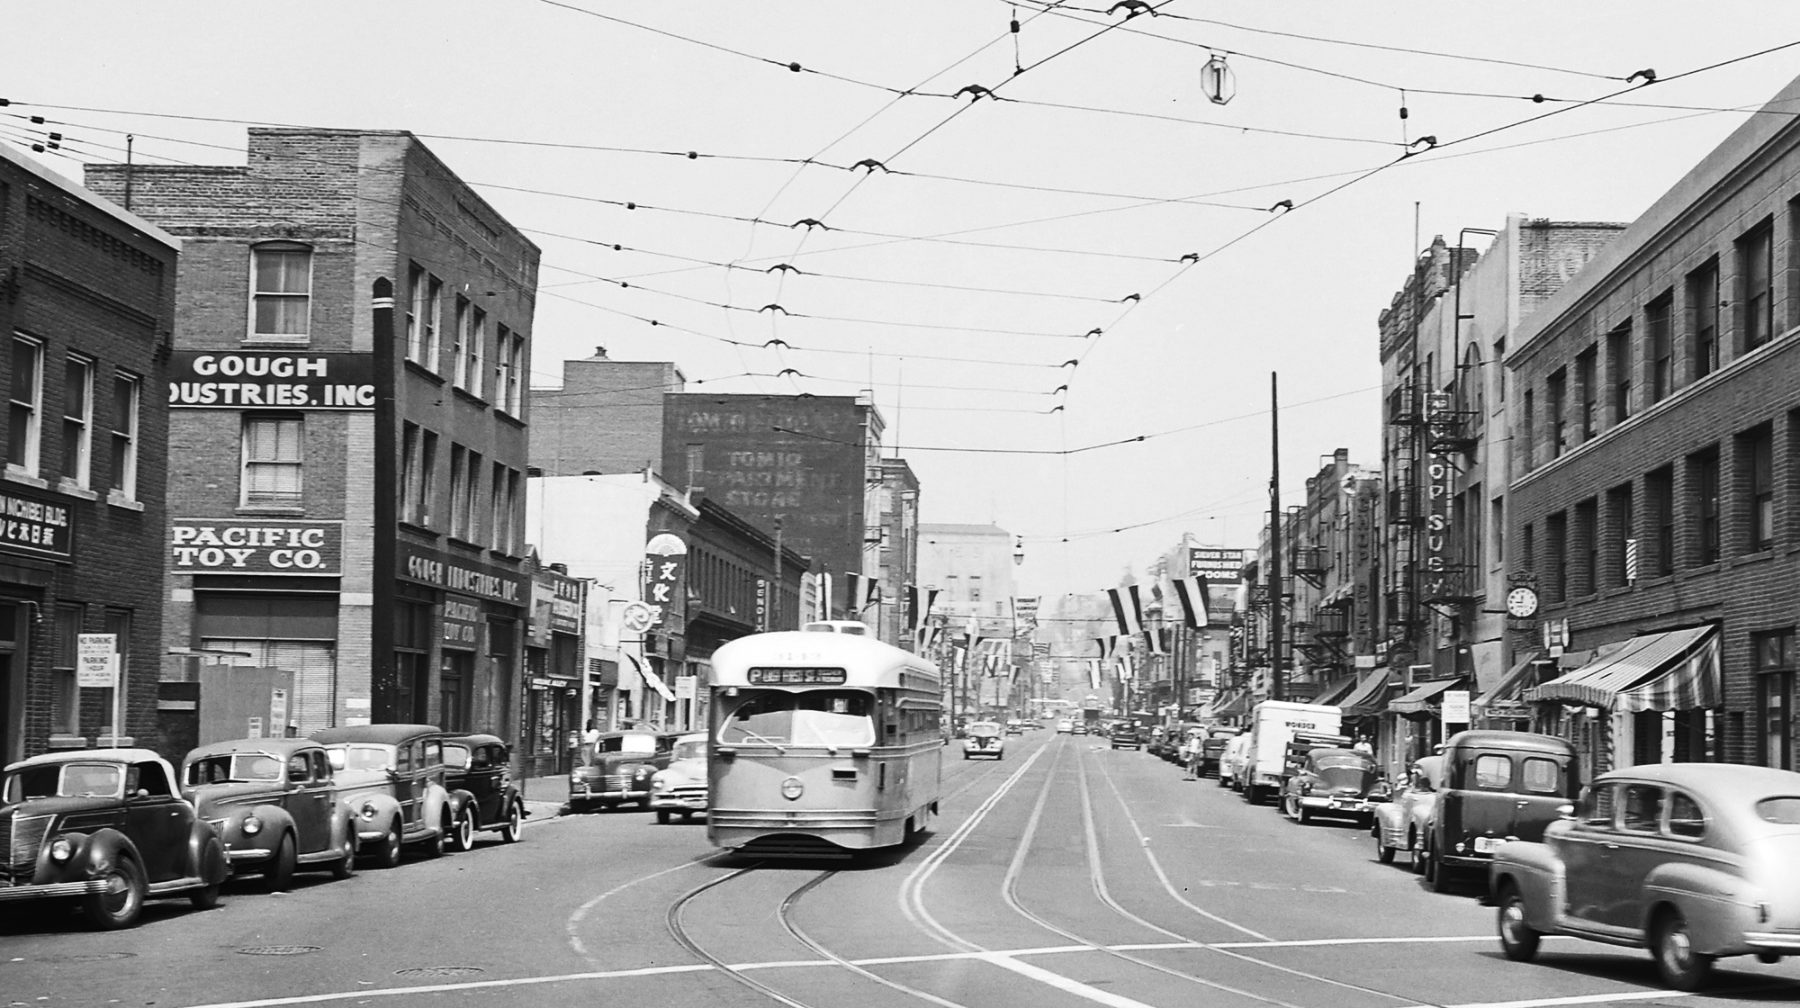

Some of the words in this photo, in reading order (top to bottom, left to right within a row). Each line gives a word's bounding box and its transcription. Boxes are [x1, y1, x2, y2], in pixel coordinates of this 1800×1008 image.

[193, 355, 327, 377] GOUGH
[171, 526, 325, 547] PACIFIC
[173, 547, 256, 567] TOY
[269, 549, 326, 569] CO.
[1222, 551, 1242, 560] STAR
